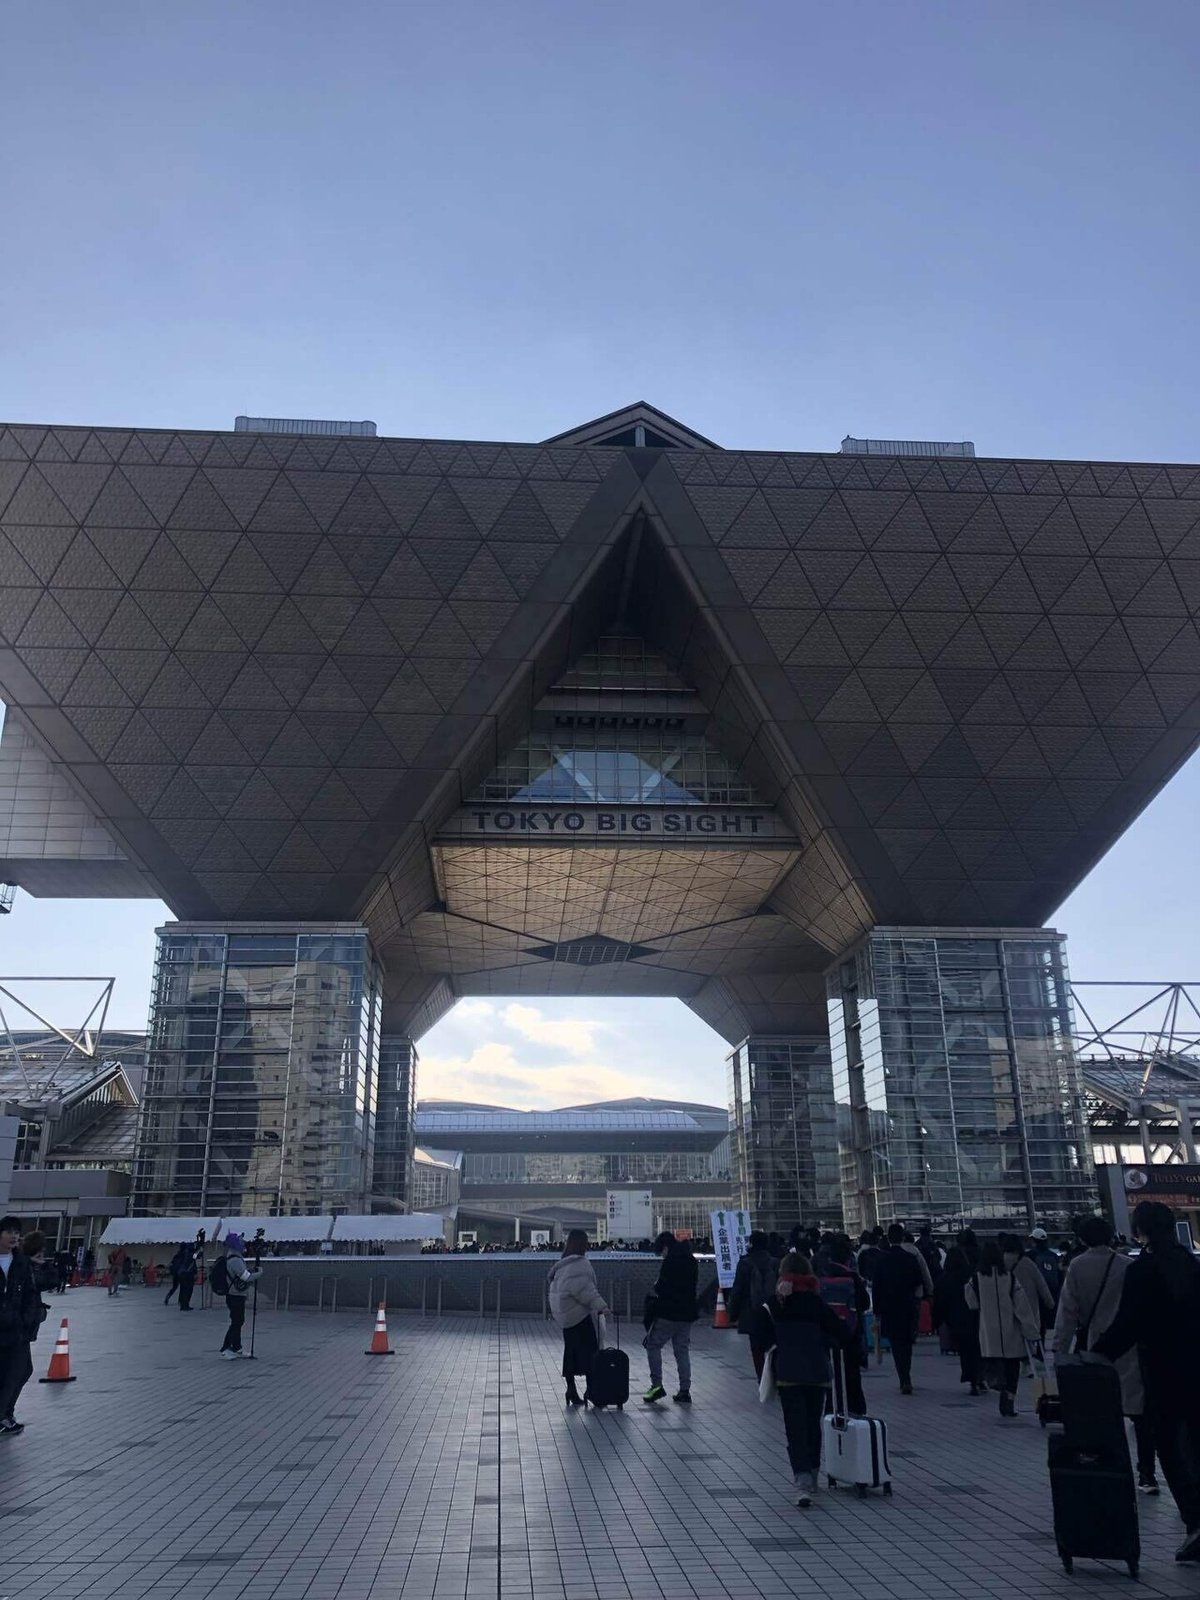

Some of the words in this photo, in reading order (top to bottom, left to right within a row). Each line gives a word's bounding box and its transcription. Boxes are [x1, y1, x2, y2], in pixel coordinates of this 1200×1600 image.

[471, 810, 585, 830] TOKYO
[597, 813, 652, 832] BIG
[663, 814, 764, 833] SIGHT
